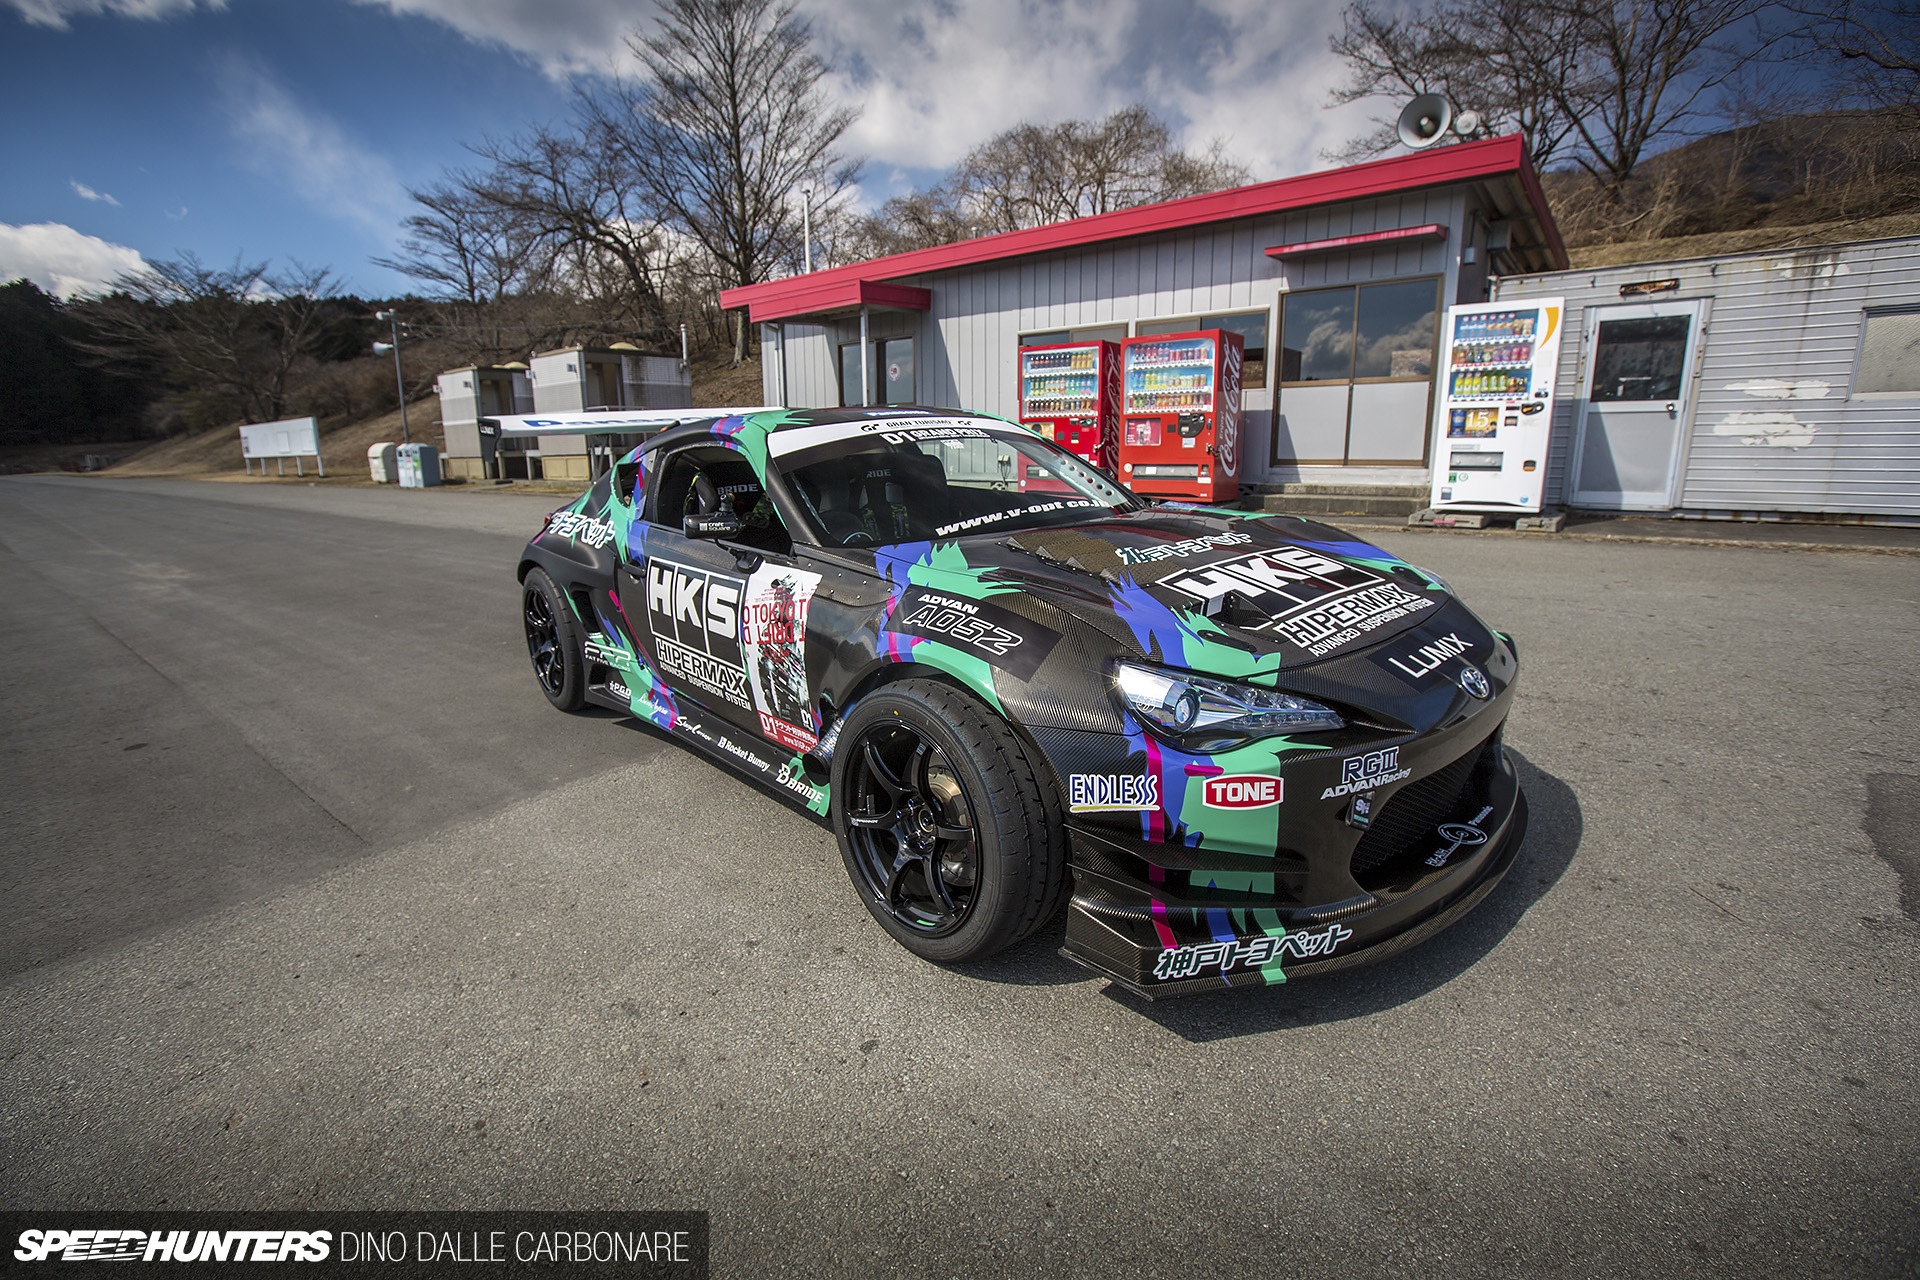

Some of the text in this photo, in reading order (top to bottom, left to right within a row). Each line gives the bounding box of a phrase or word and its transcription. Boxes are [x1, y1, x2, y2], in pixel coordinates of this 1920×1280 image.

[1219, 334, 1243, 477] Coca-Cola
[880, 430, 916, 445] D1
[717, 483, 758, 495] BRIDE
[866, 469, 892, 478] RIDE
[1174, 551, 1345, 598] HKS
[649, 566, 739, 639] HKS
[752, 600, 795, 624] TOKYO
[918, 594, 979, 615] ADVAN
[1272, 582, 1421, 648] HIPERMAX
[902, 604, 1023, 656] A052
[1308, 597, 1435, 657] ADVANCED SUSPENSION SYSTEM
[655, 637, 749, 700] HIPERMAX
[1388, 632, 1474, 679] LUMIX
[725, 691, 752, 711] SYSTEM
[724, 740, 770, 773] Rocket Bunny
[786, 778, 825, 804] BRIDE
[1070, 774, 1158, 805] ENDLESS
[1211, 781, 1276, 803] TONE
[1320, 767, 1412, 800] ADVAN Racing
[1153, 924, 1353, 980] 神戸トヨペット
